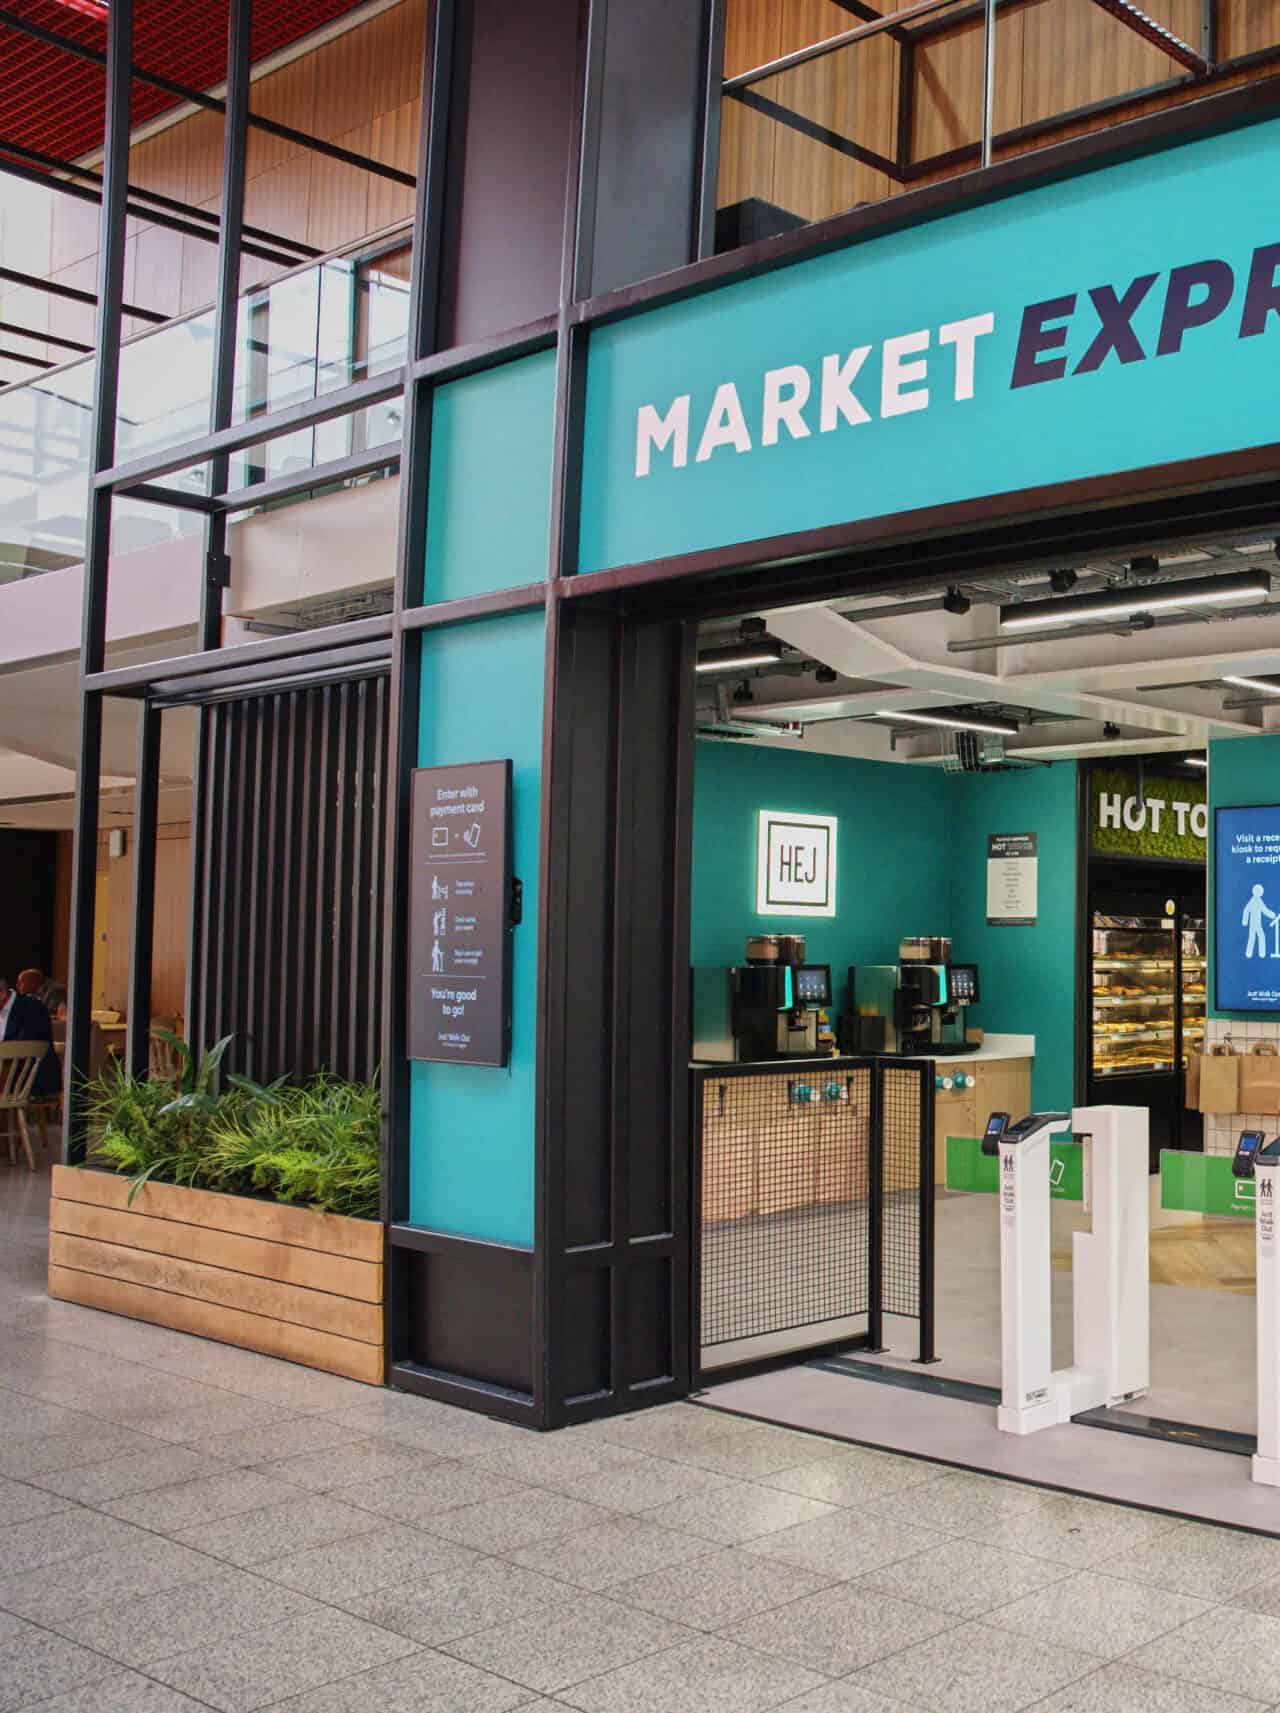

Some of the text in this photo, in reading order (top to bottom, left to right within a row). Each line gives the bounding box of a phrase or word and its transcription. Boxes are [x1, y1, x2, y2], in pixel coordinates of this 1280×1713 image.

[635, 312, 995, 479] MARKET
[436, 785, 479, 800] Enter with
[429, 800, 485, 817] payment card
[1100, 792, 1208, 837] HOT TO
[1235, 833, 1254, 843] Visit
[779, 844, 817, 884] HEJ
[431, 988, 477, 1003] You're good
[442, 1003, 451, 1015] to
